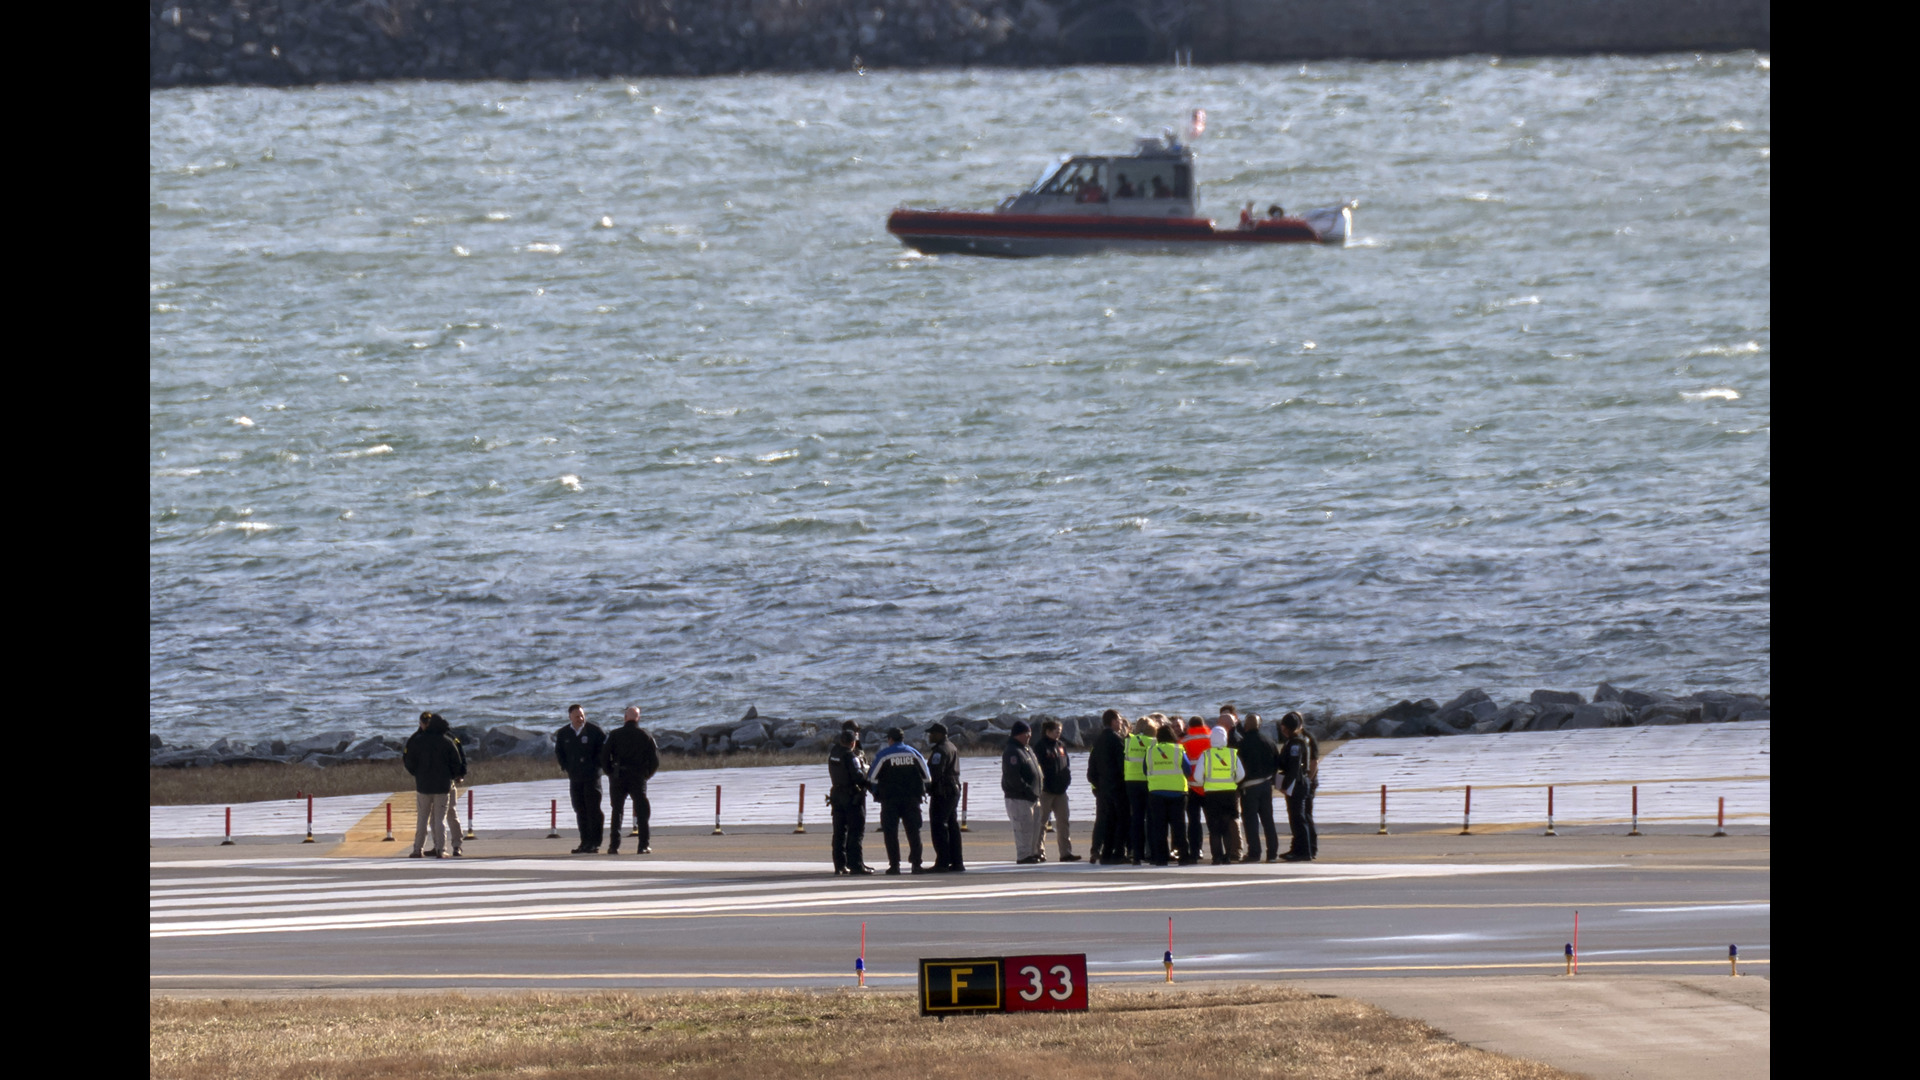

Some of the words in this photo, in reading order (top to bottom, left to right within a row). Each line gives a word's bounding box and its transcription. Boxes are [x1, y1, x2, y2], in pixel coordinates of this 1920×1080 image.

[890, 757, 914, 766] POLICE
[951, 968, 973, 1004] F
[1019, 965, 1073, 1001] 33
